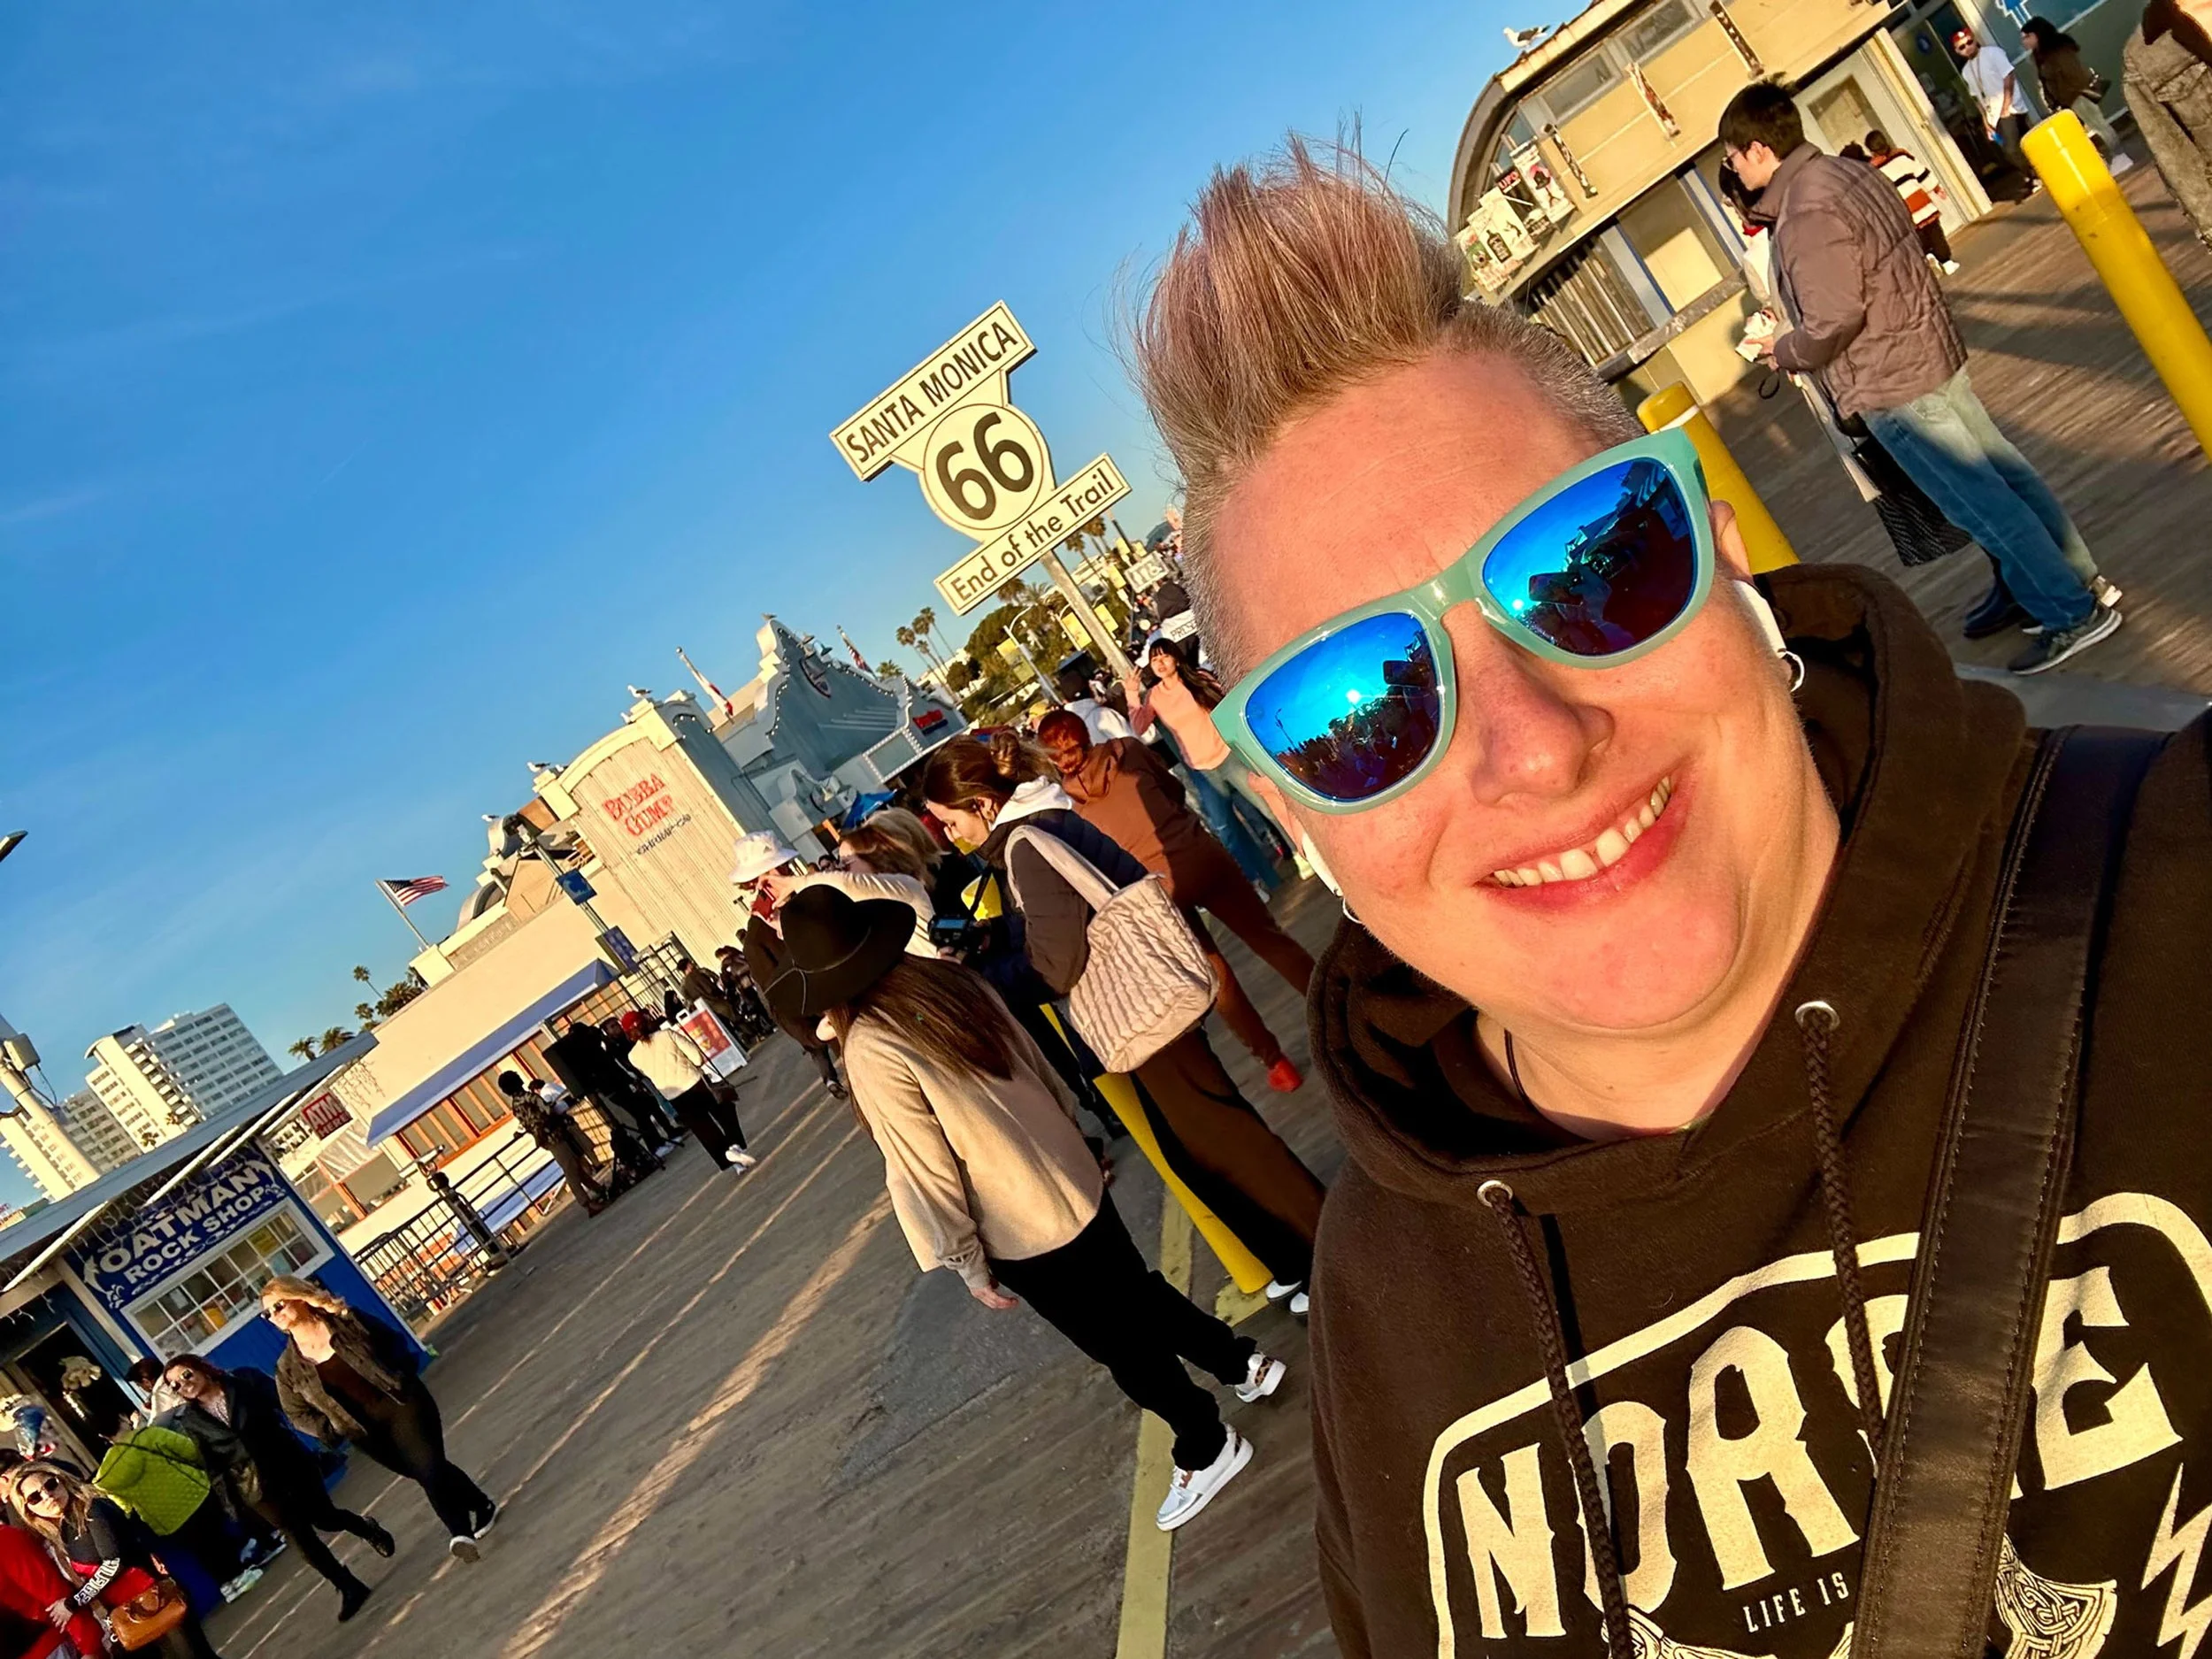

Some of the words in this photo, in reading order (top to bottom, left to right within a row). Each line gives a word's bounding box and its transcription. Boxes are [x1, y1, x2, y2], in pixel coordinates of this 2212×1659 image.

[1498, 171, 1519, 188] UFO
[846, 395, 925, 463] SANTA
[918, 321, 1018, 408] MONICA
[936, 411, 1033, 521] 66
[951, 557, 997, 602] End
[1002, 534, 1025, 566] of
[1025, 516, 1063, 549] the
[1060, 469, 1114, 518] Trail
[603, 772, 664, 821] BUBBA
[625, 795, 674, 836] GUMP
[305, 1096, 342, 1130] ATM
[319, 1112, 349, 1138] HERE
[99, 1166, 260, 1273] OATMAN
[124, 1229, 202, 1284] ROCK
[203, 1187, 265, 1233] SHOP
[1742, 1587, 1806, 1633] LIFE
[1816, 1571, 1849, 1606] IS
